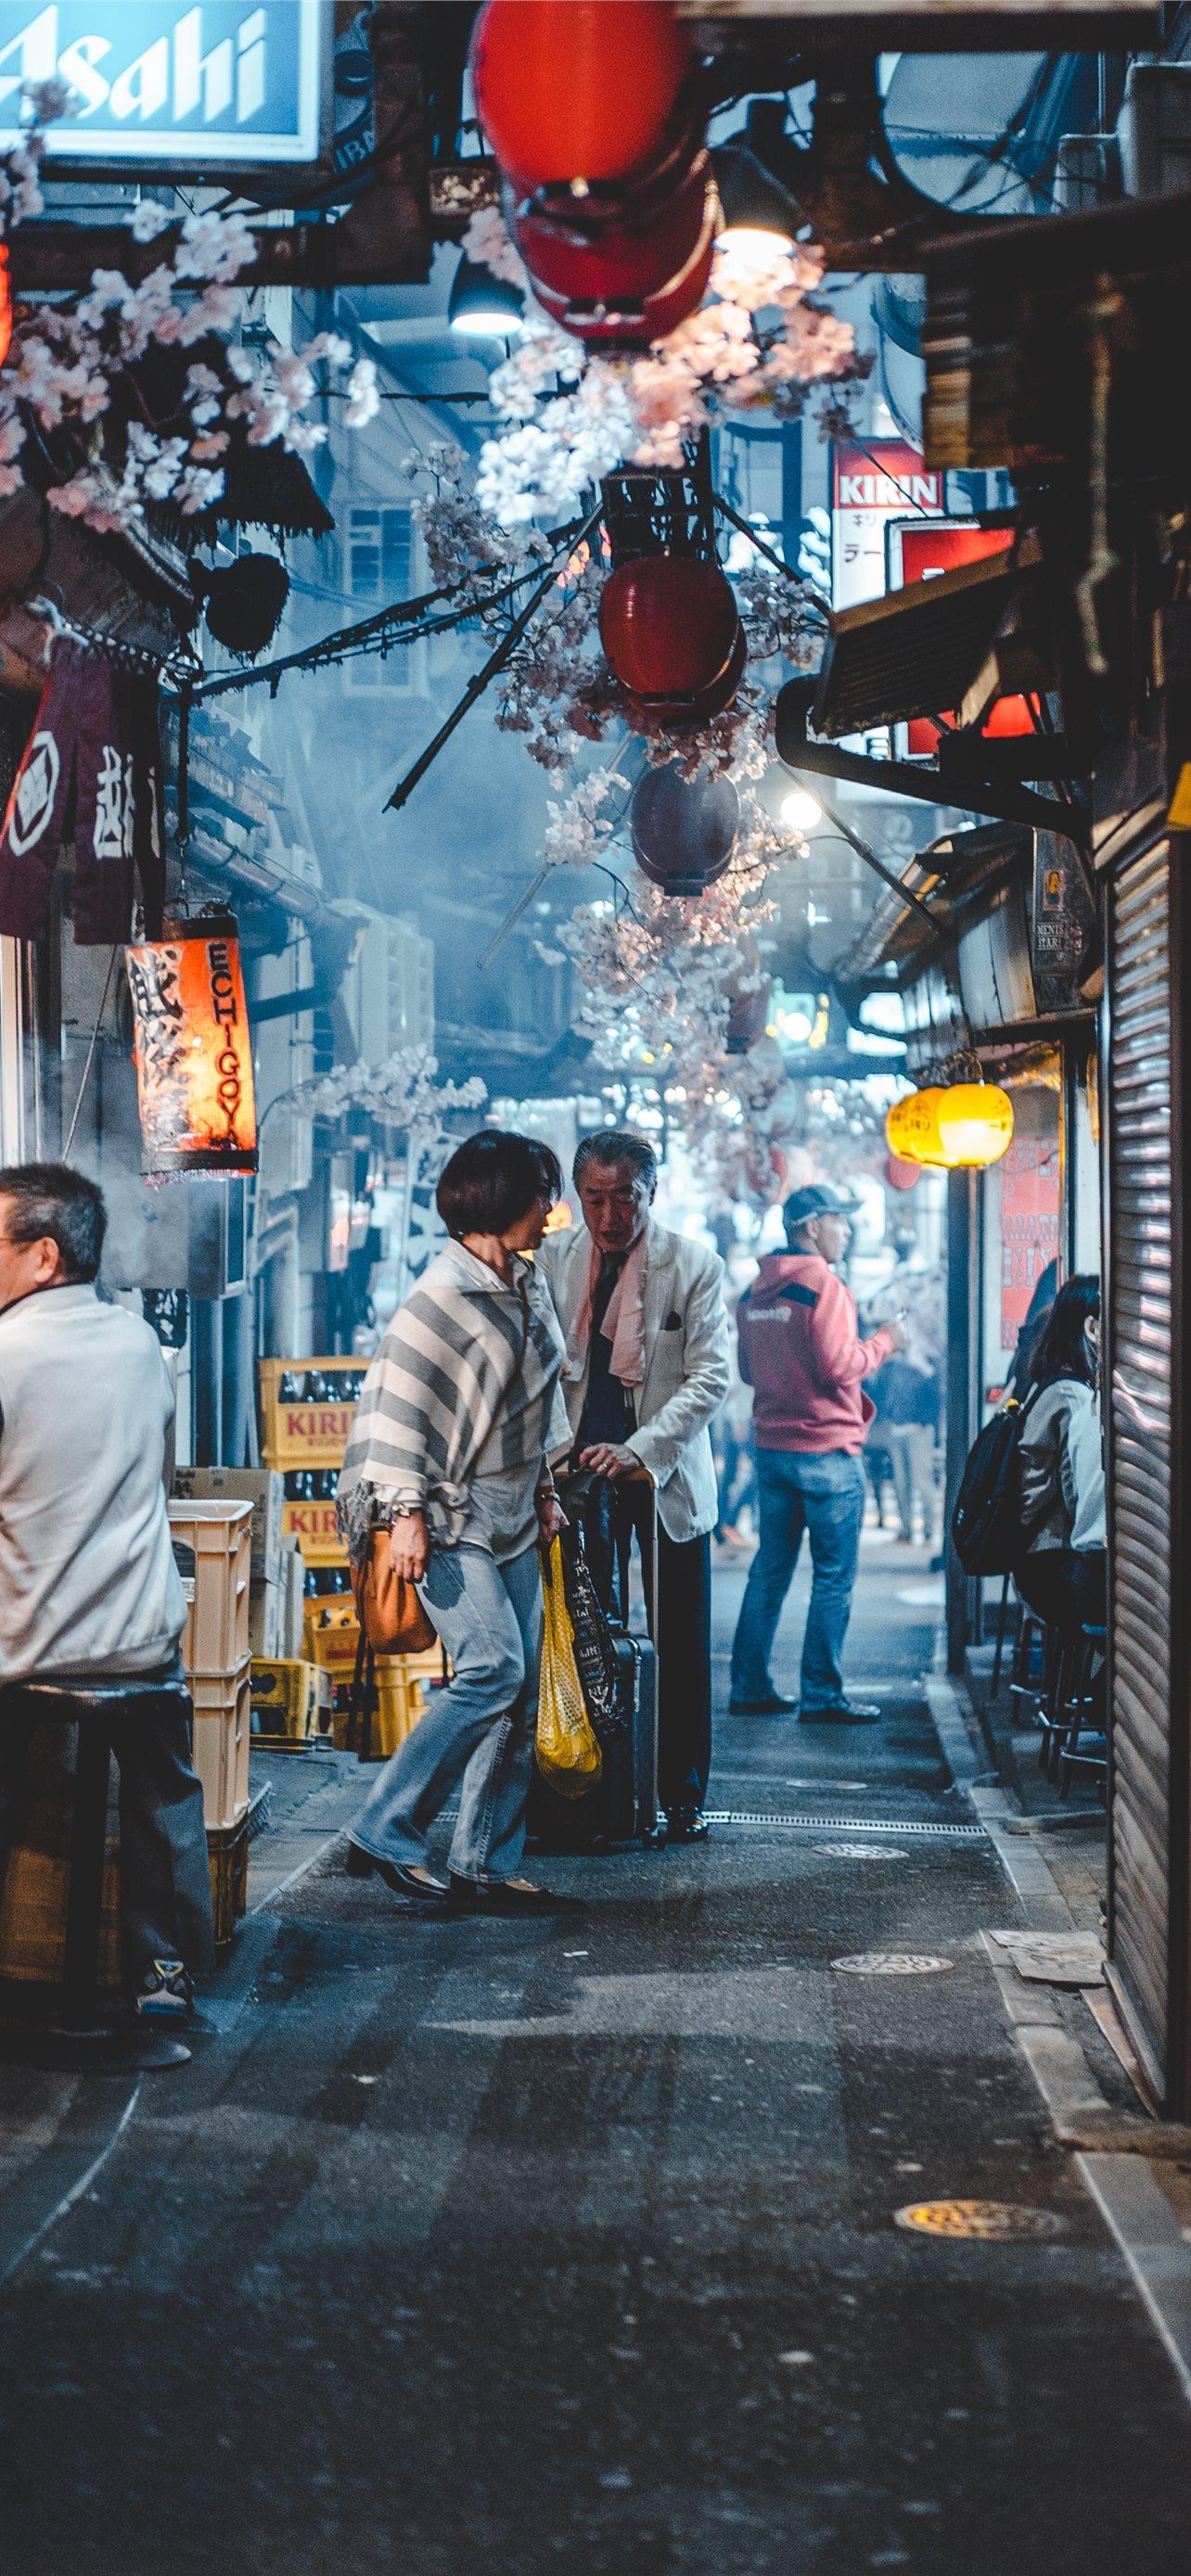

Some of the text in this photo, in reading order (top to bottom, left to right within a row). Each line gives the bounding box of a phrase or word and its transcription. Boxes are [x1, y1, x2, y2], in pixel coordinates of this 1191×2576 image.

[0, 4, 266, 122] Asahi
[839, 474, 938, 505] KIRIN
[287, 1412, 353, 1436] KIRI
[288, 1510, 338, 1533] KIR
